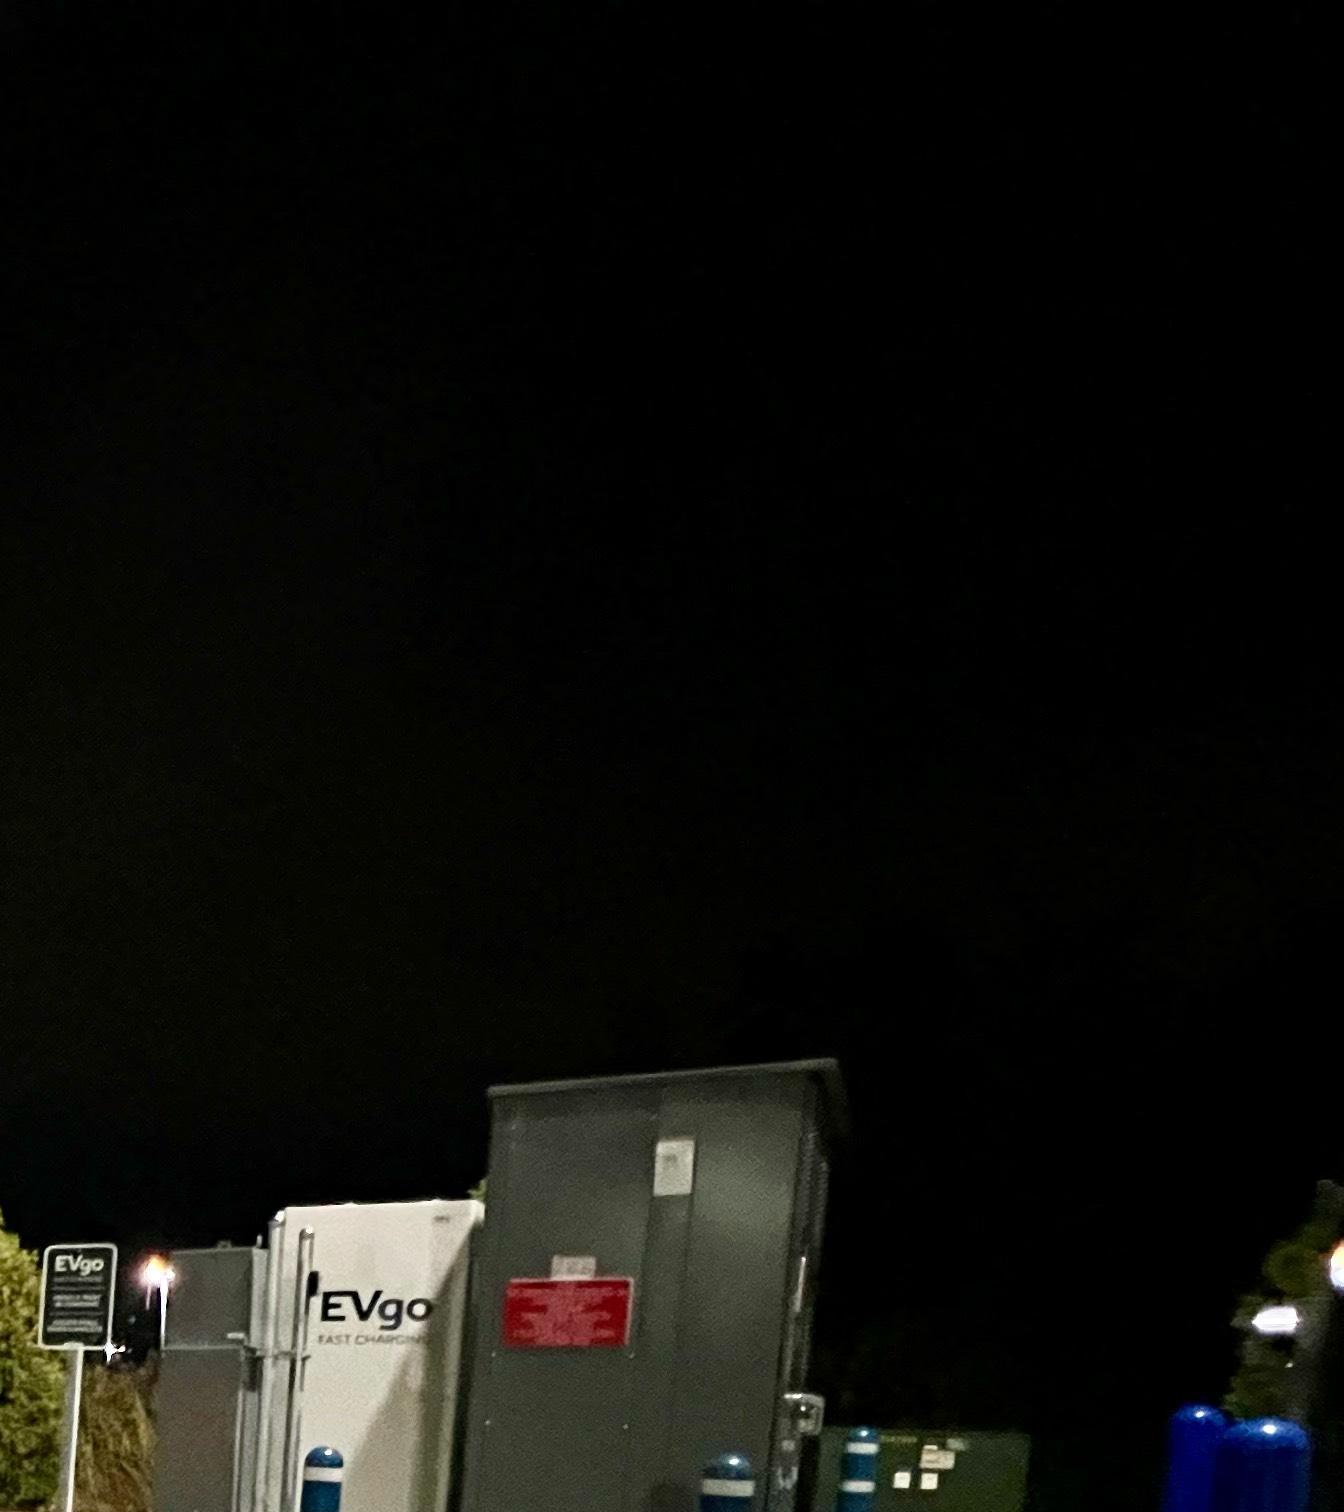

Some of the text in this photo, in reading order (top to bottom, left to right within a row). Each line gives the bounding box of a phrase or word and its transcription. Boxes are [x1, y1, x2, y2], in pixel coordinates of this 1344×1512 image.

[54, 1253, 105, 1277] EVgo
[319, 1289, 434, 1332] EVgo
[318, 1334, 352, 1345] FAST
